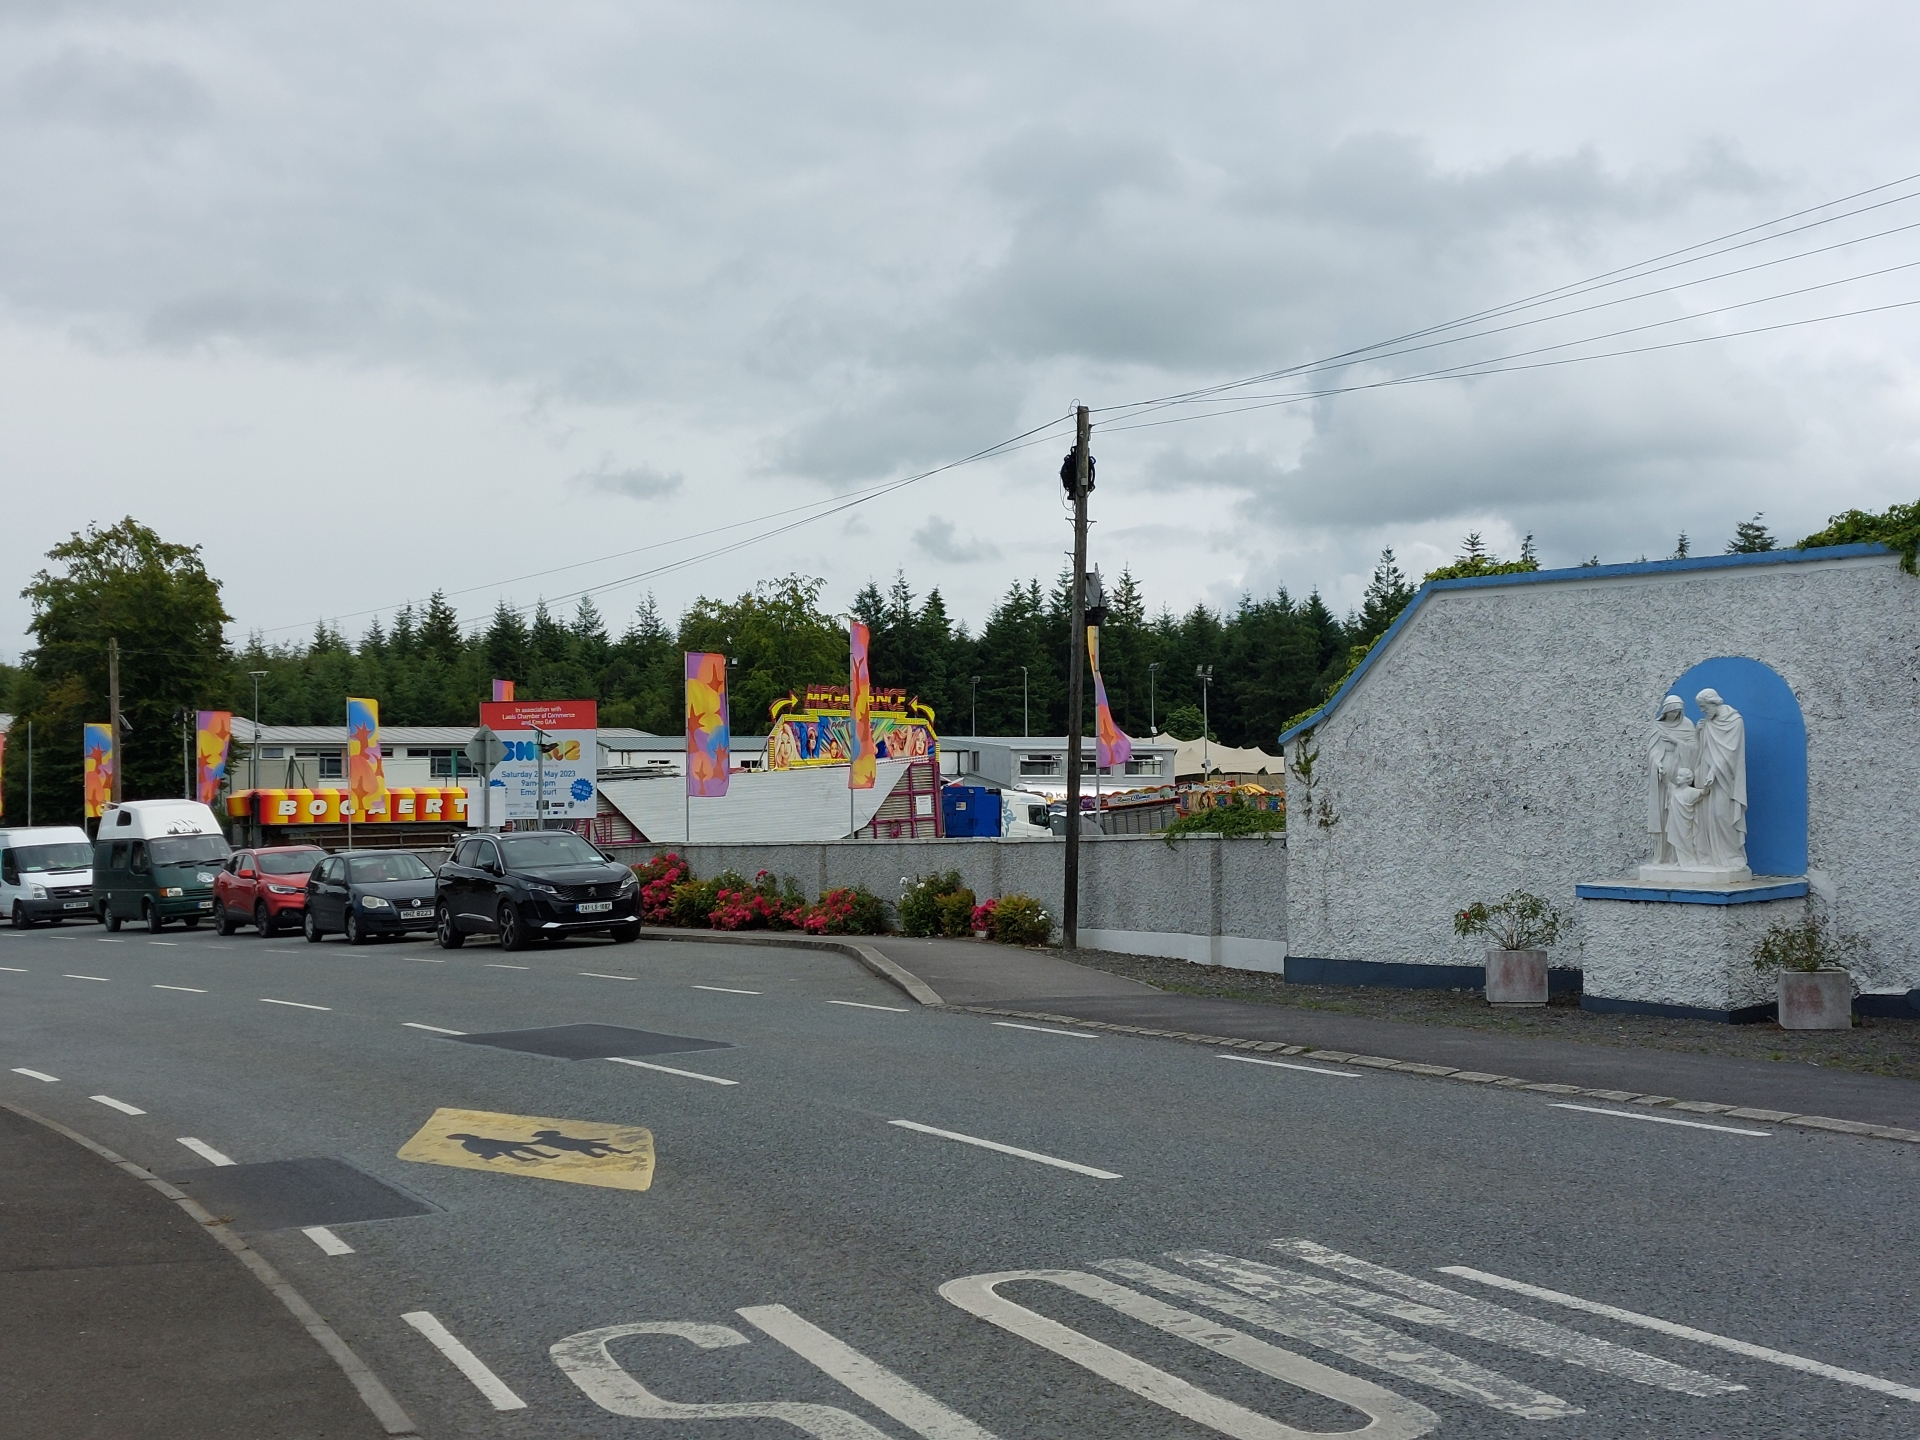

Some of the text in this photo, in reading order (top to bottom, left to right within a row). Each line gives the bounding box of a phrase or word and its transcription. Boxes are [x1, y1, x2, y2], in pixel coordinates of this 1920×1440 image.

[501, 770, 533, 779] Saturday
[544, 770, 558, 779] May
[560, 770, 576, 778] 2023
[520, 788, 557, 796] Emo ourt
